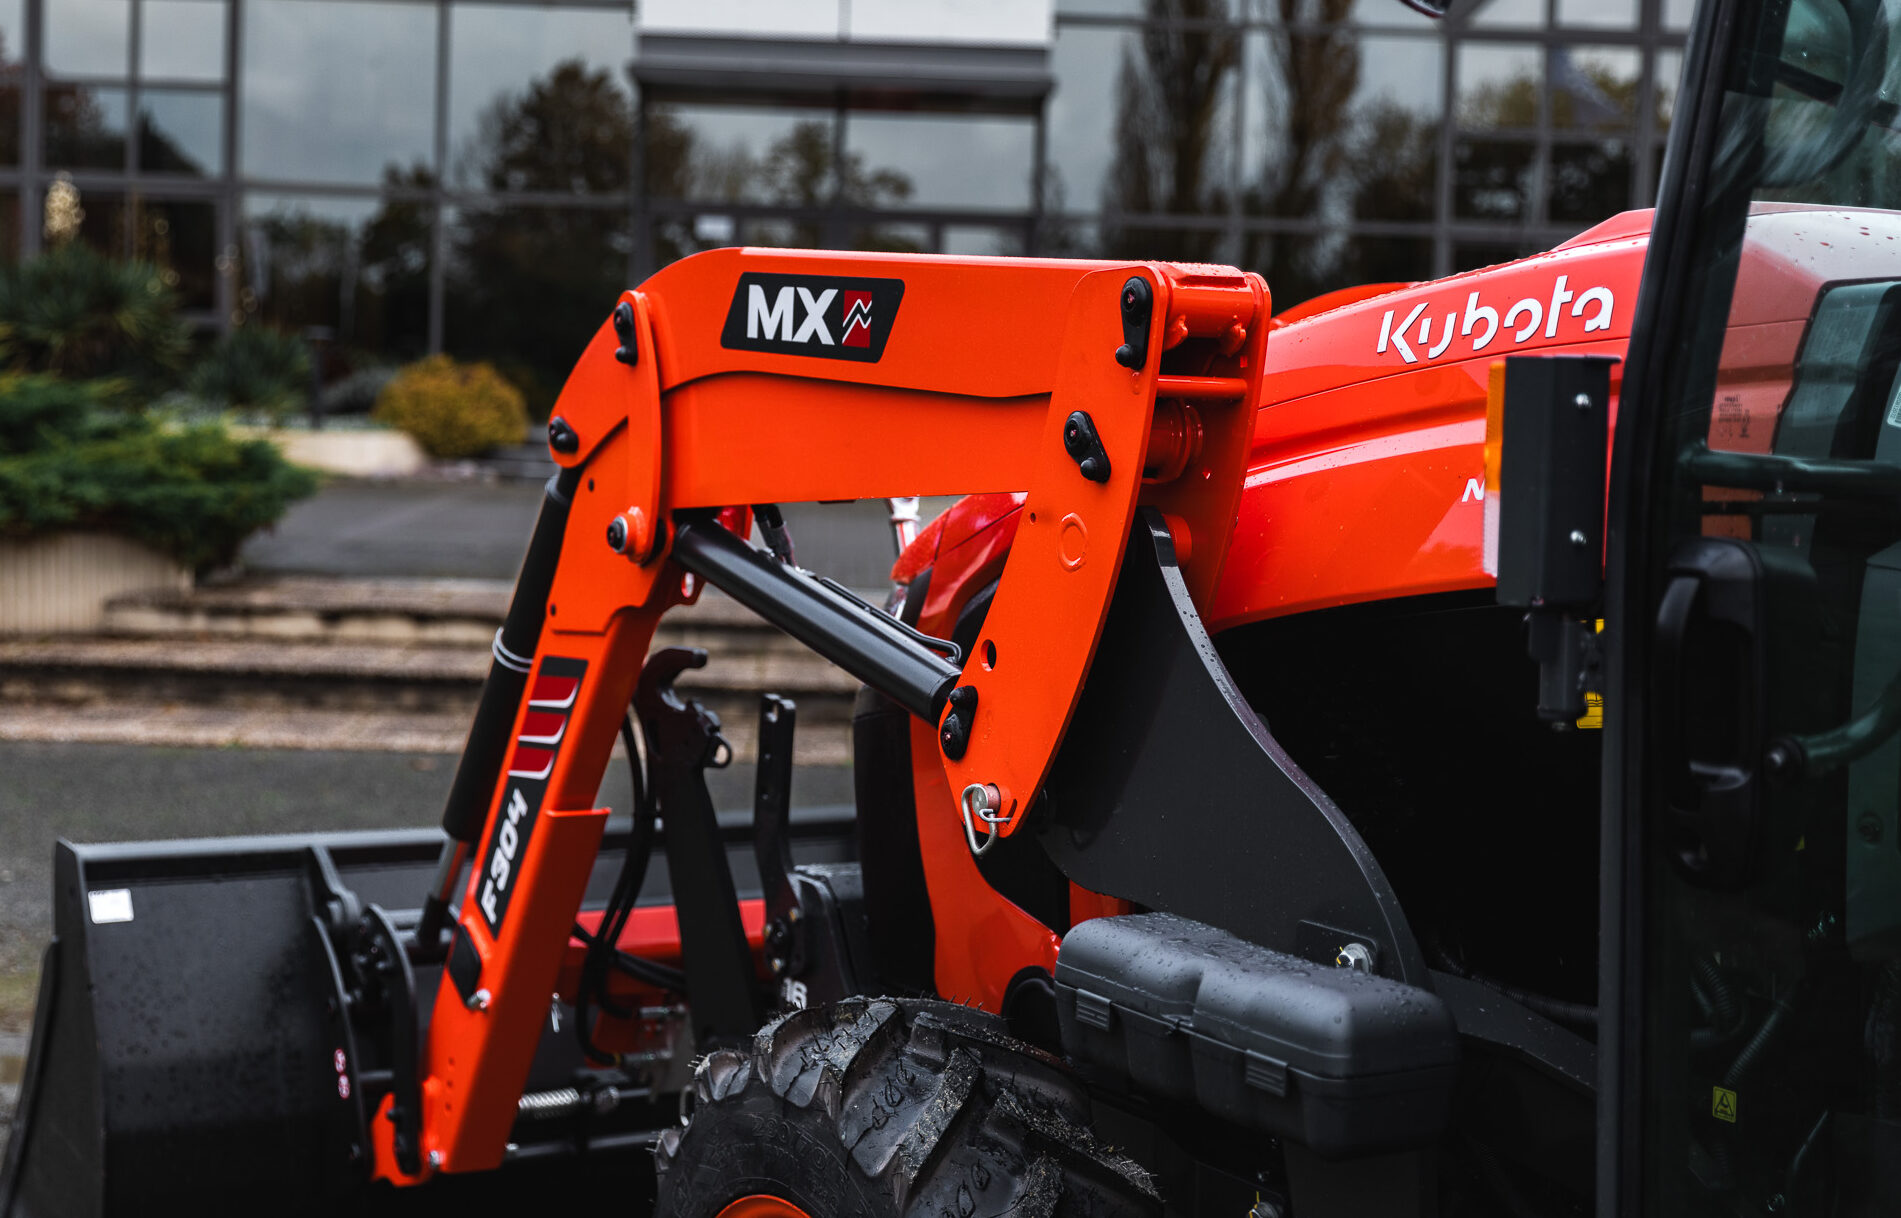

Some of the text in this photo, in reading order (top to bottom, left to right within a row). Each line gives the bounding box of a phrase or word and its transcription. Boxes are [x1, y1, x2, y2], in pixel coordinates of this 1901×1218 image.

[747, 284, 838, 345] MX
[1377, 275, 1613, 363] Kubota
[481, 788, 528, 924] F304
